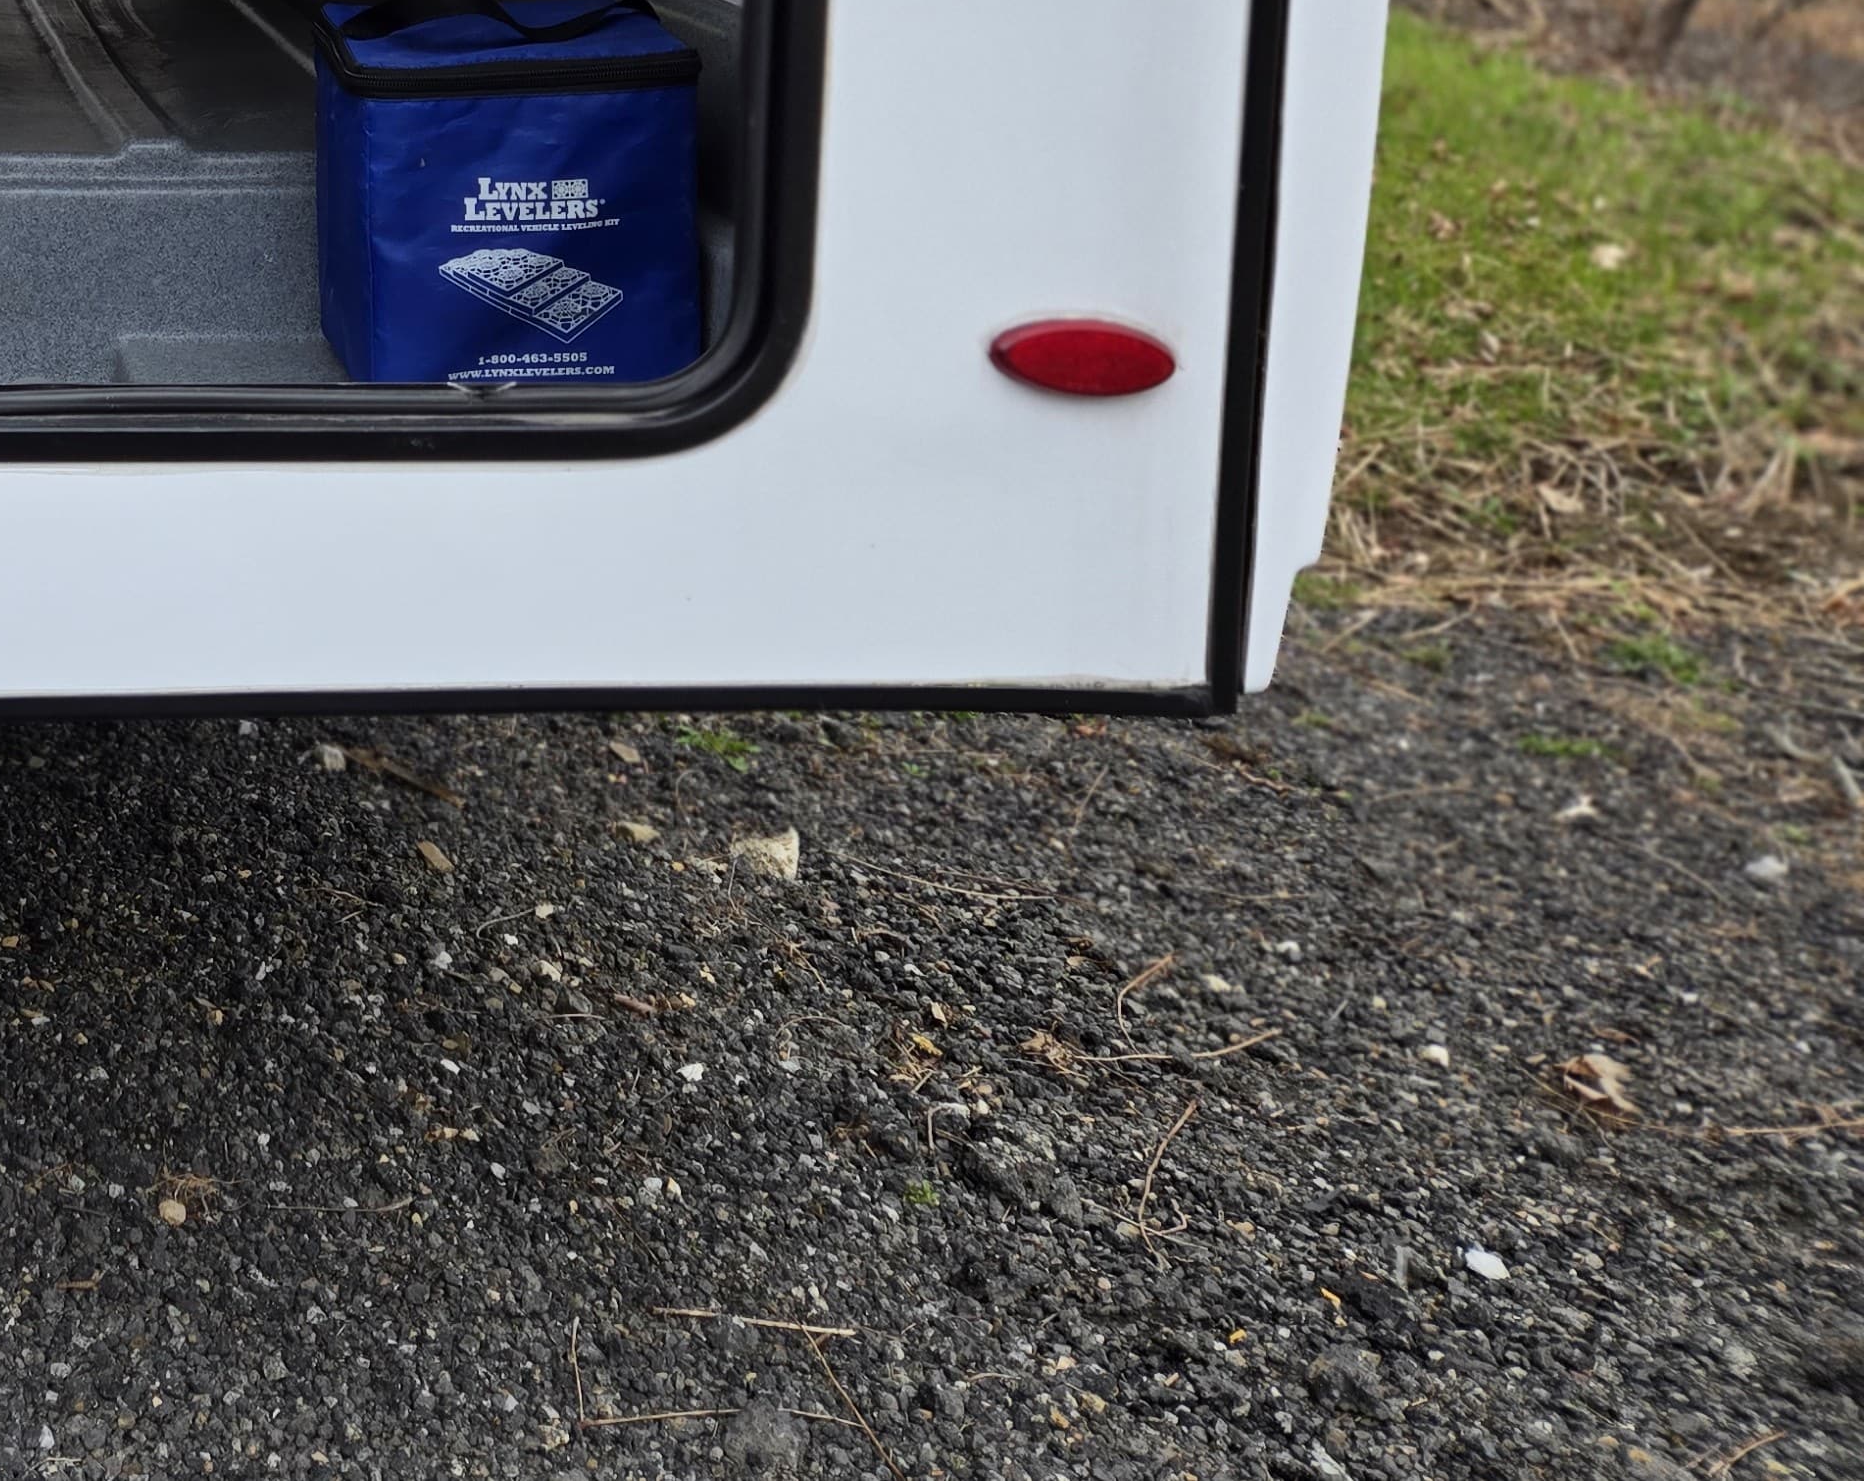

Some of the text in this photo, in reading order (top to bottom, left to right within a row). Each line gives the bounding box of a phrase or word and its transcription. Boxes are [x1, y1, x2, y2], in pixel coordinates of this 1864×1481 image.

[478, 177, 547, 200] LYNX
[451, 218, 620, 233] RECREATIONAL VEHICLE LEVELING KIT
[478, 352, 588, 365] 1-800-463-5505
[448, 365, 615, 380] WWW.LYNXLEVELERS.COM
